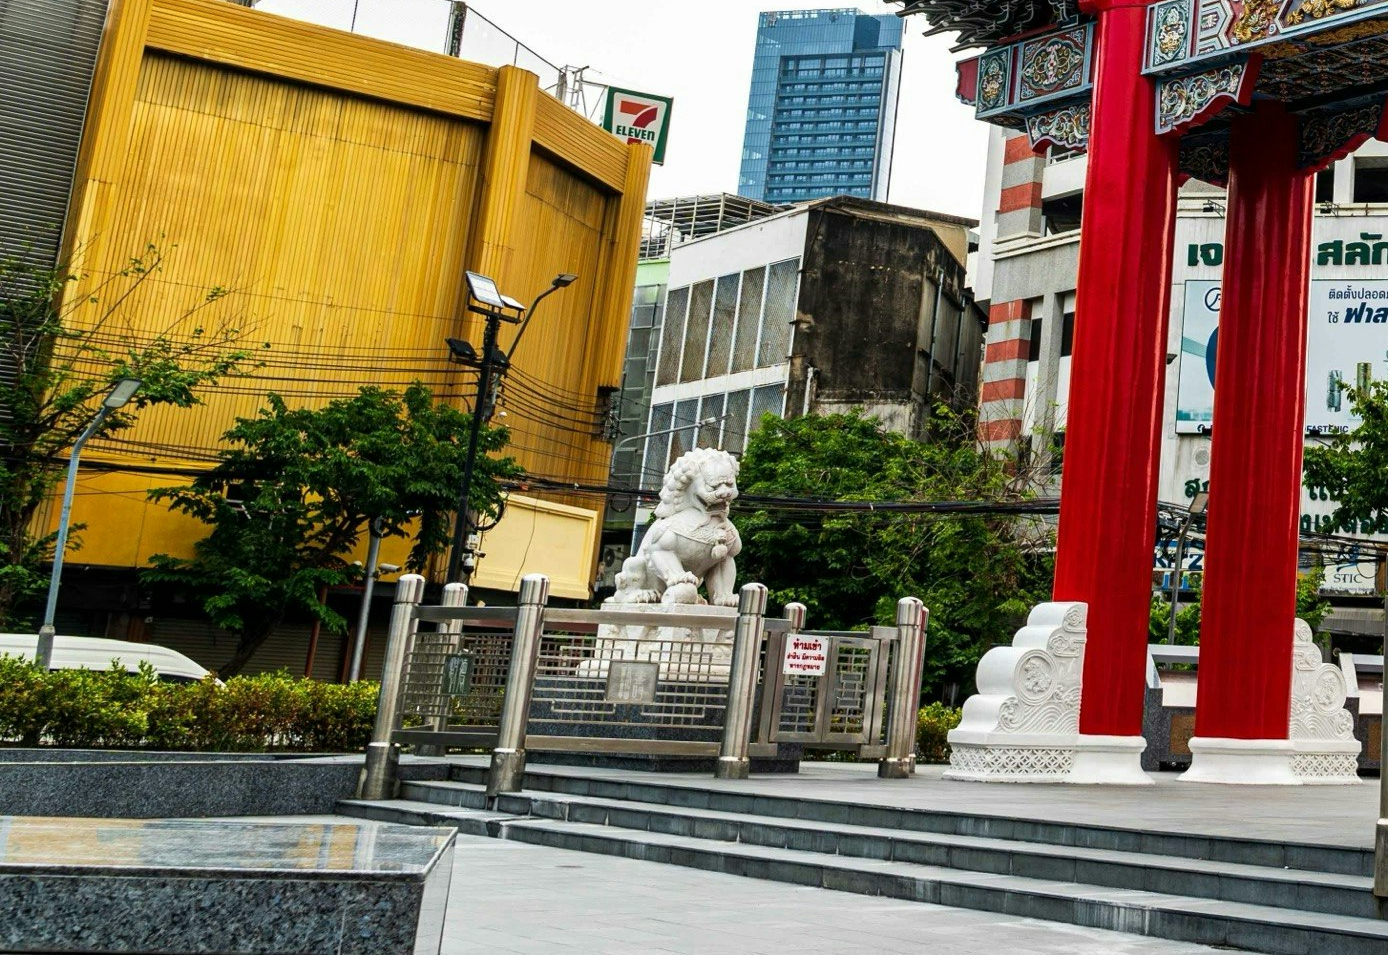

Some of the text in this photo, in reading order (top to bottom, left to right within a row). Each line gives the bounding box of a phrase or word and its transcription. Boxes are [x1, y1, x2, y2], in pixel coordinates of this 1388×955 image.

[1327, 311, 1339, 324] ใช้
[1333, 573, 1363, 584] STIC
[793, 638, 822, 651] ห้ามเข้า
